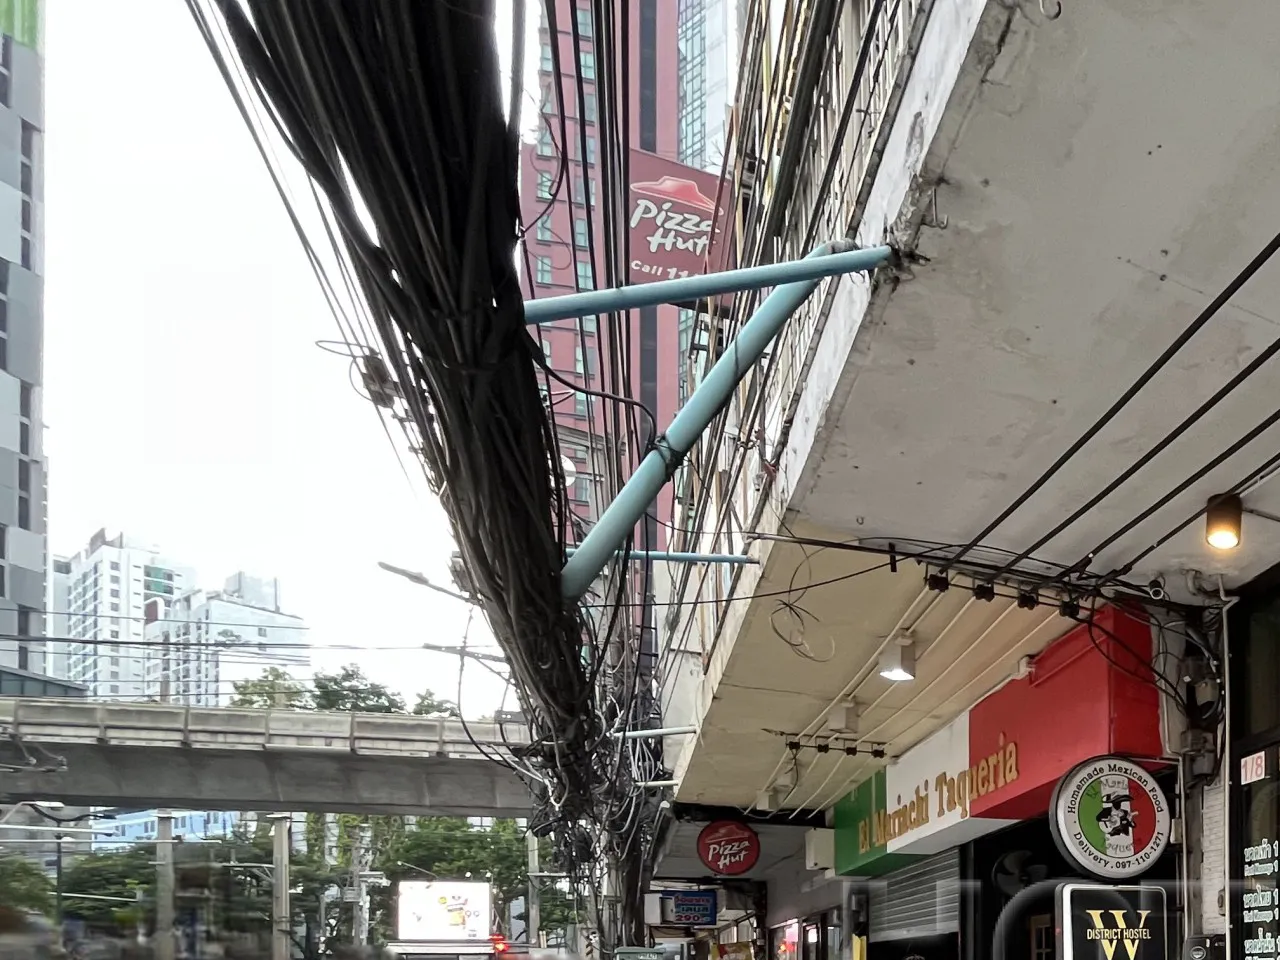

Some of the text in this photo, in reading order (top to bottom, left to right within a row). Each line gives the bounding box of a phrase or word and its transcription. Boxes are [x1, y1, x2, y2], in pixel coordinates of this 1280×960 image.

[630, 199, 720, 234] Pizza
[647, 228, 716, 256] Hut
[874, 779, 930, 847] Mariachi
[935, 731, 1019, 819] Taqueria
[1067, 763, 1164, 814] Homemade Mexican Food
[708, 841, 750, 861] Pizza
[718, 851, 748, 869] Hut
[1087, 928, 1151, 940] DISTRICT HOSTEL
